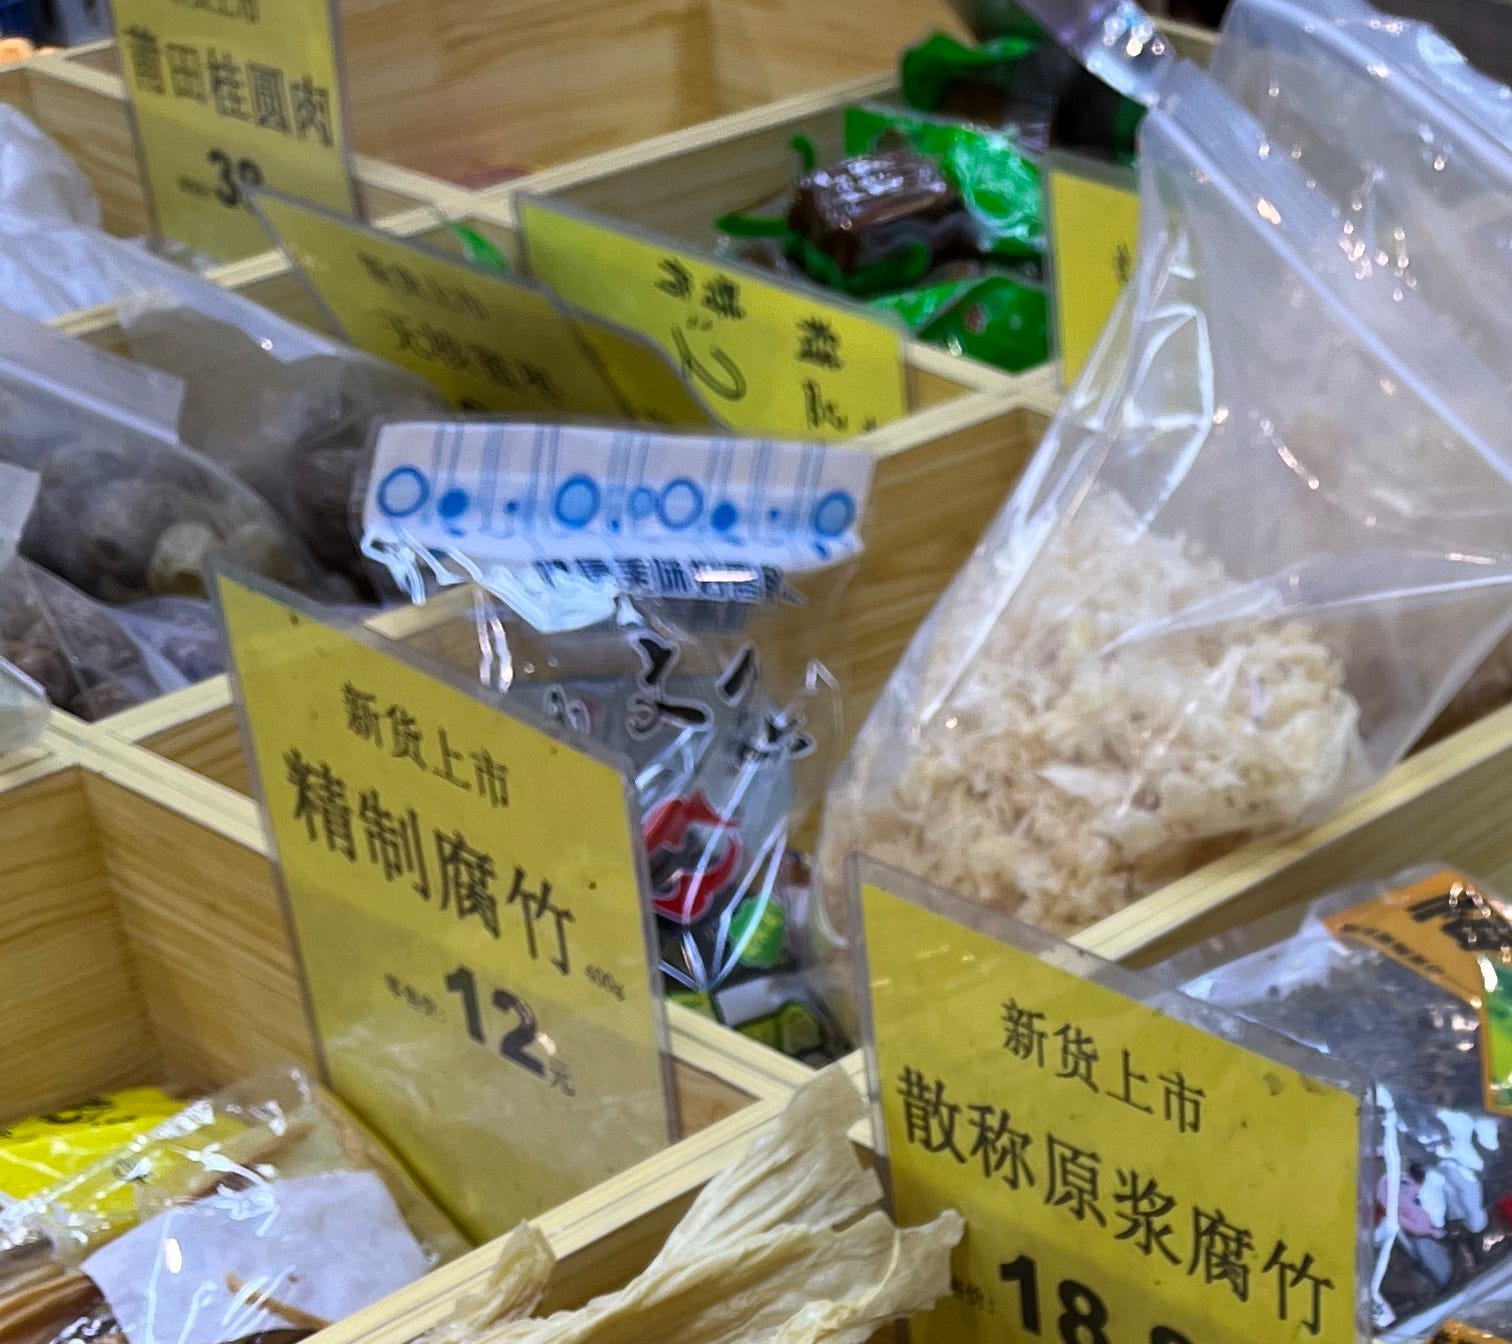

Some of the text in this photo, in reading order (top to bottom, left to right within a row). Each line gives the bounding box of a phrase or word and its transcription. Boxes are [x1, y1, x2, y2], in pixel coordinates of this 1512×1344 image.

[341, 681, 511, 808] 新货上市
[281, 747, 577, 977] 精制腐竹
[444, 965, 549, 1077] 12
[1001, 997, 1207, 1135] 新货上市
[896, 1065, 1337, 1337] 散称原浆腐竹
